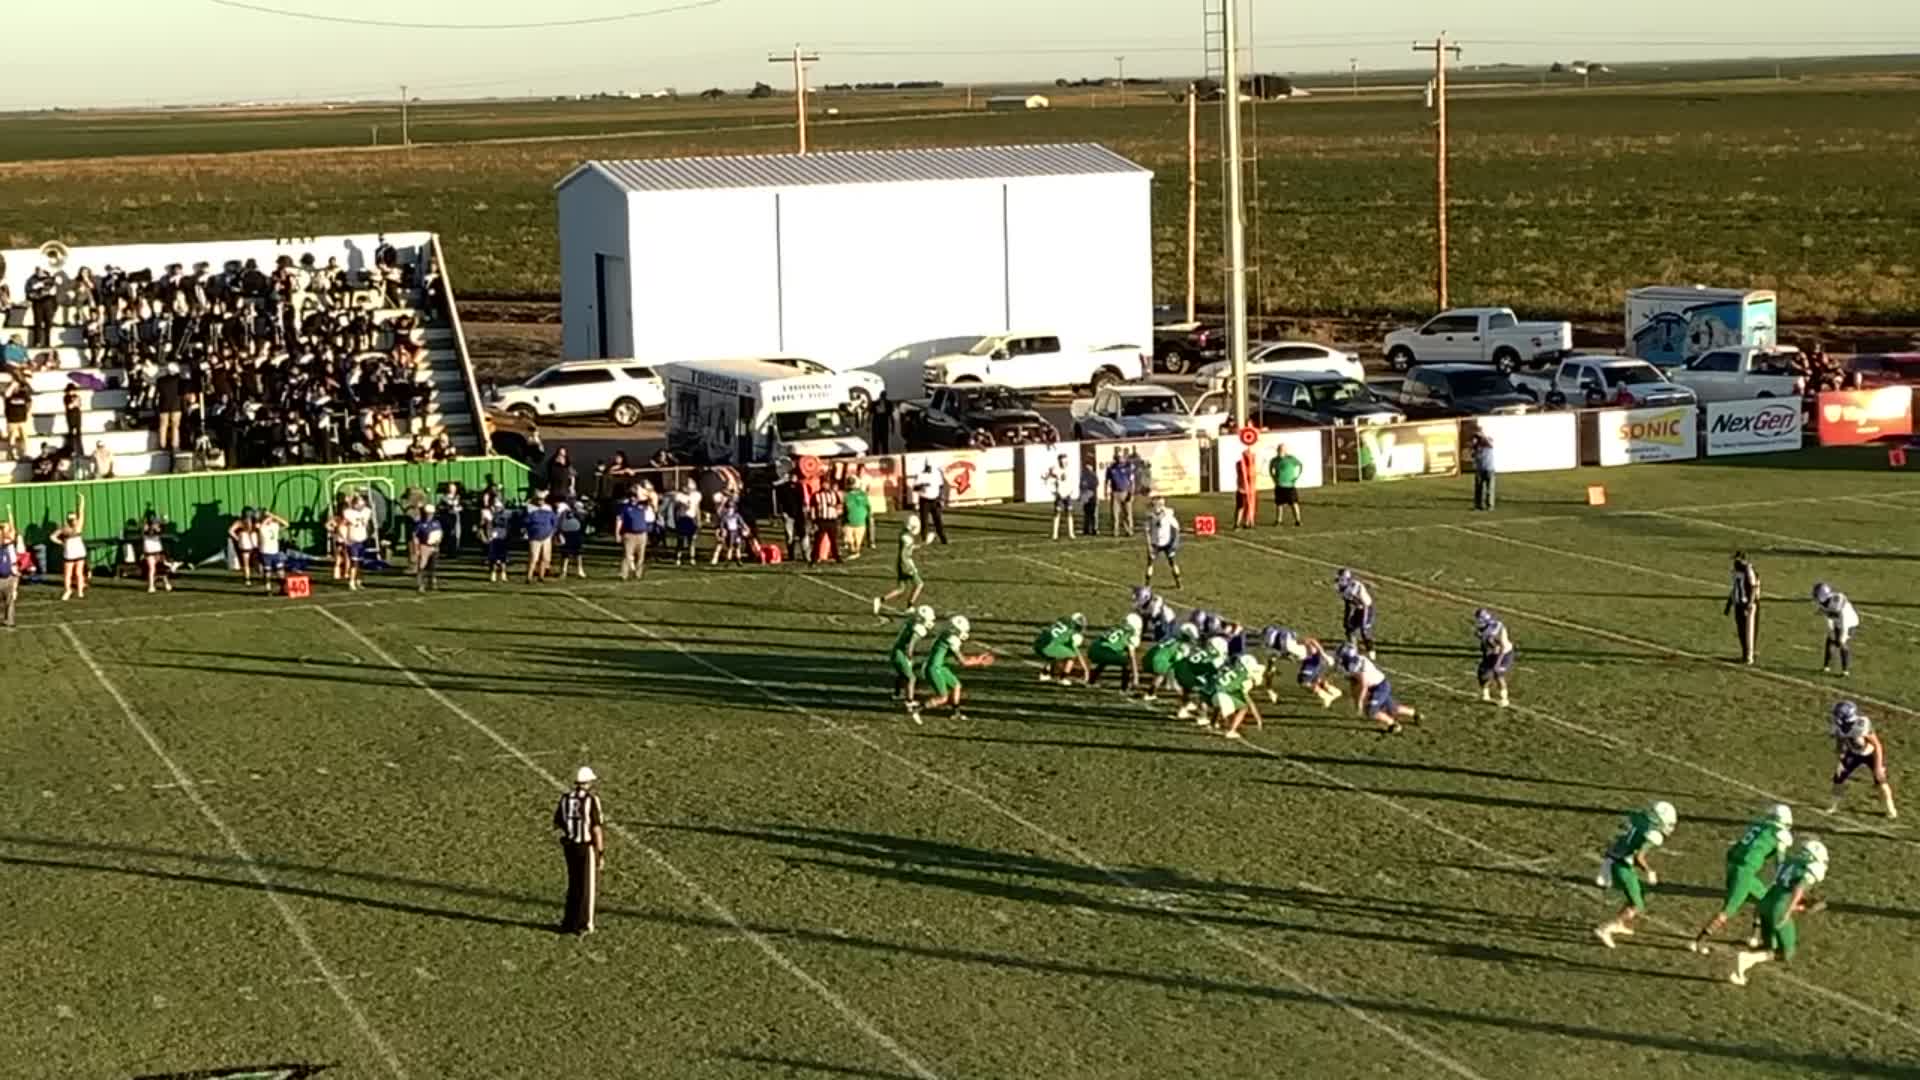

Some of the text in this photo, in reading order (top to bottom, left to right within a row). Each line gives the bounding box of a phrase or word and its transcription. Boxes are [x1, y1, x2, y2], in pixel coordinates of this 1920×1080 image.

[1619, 418, 1682, 441] SONIC
[1711, 410, 1794, 434] NexGen
[1198, 519, 1213, 532] 20
[290, 579, 308, 594] 40
[568, 798, 581, 817] R
